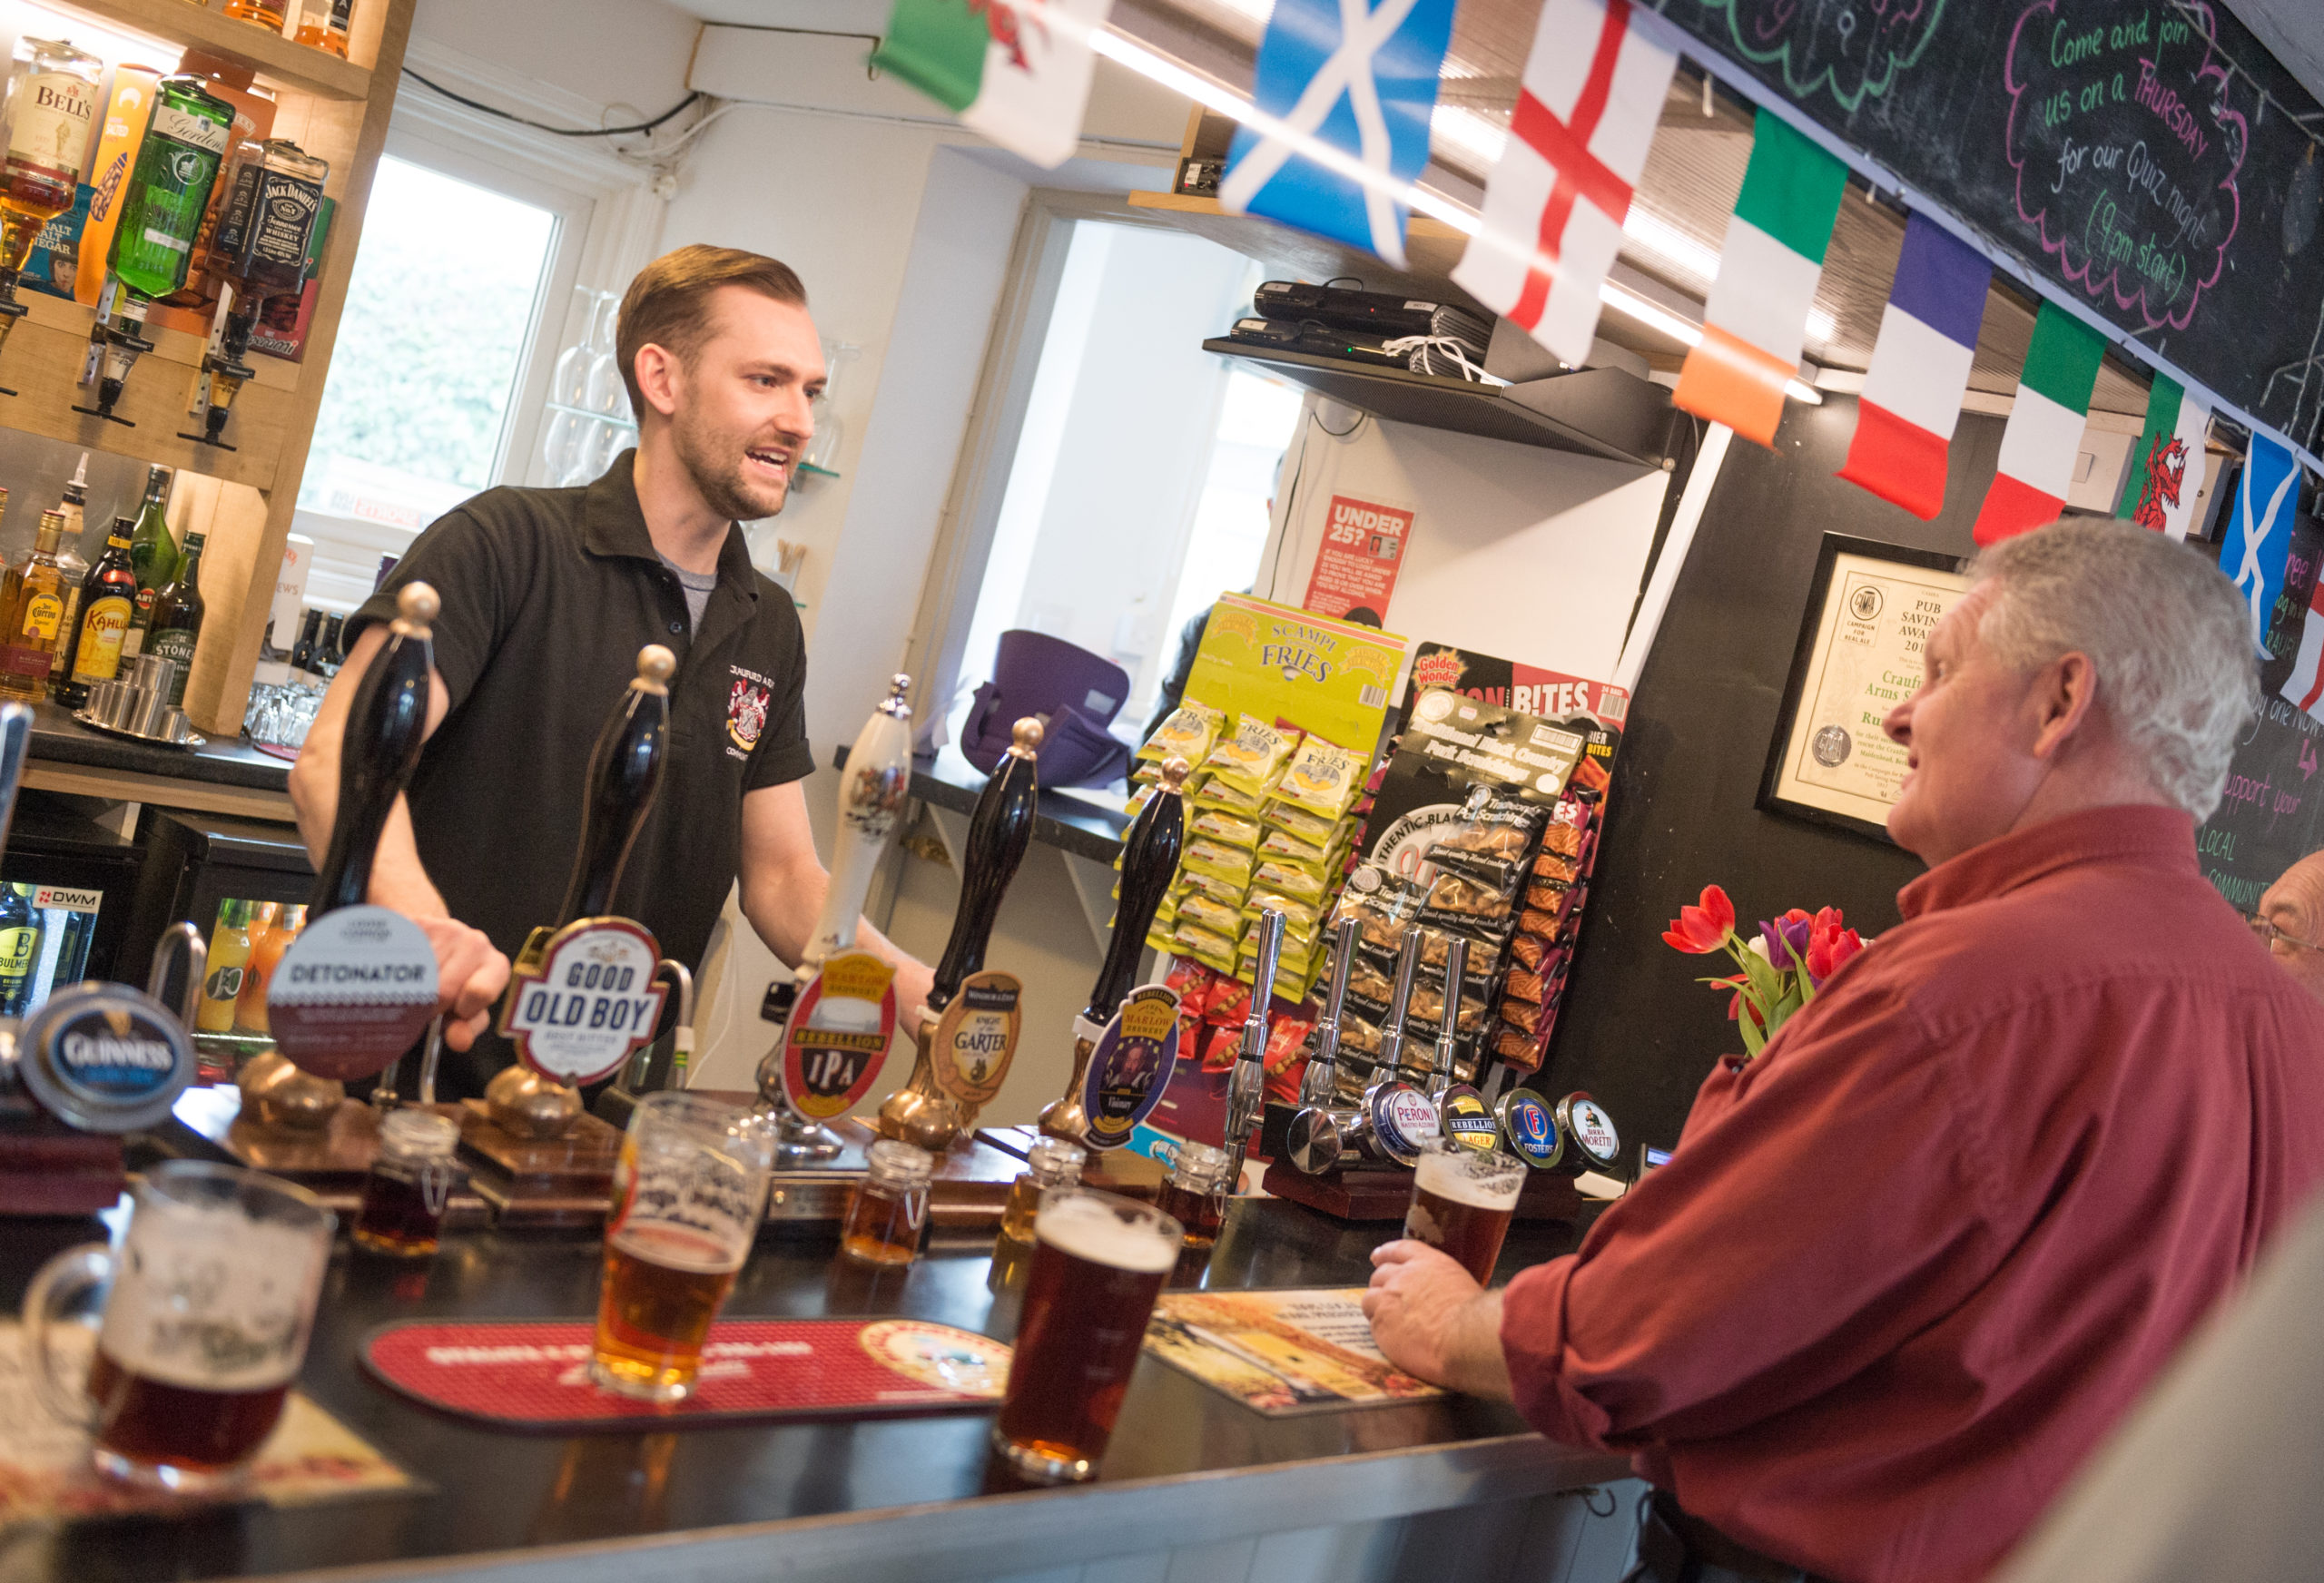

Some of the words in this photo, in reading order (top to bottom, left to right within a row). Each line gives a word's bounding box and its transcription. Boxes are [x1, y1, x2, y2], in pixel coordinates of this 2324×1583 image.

[2051, 18, 2103, 68] Come
[2111, 9, 2149, 50] and
[2143, 11, 2189, 81] join
[35, 85, 92, 120] BELL'S
[2045, 91, 2071, 127] us
[2081, 81, 2104, 113] on
[2112, 73, 2126, 102] a
[2134, 57, 2208, 162] THURSDAY
[265, 184, 287, 199] JACK
[287, 182, 318, 212] DANIEL'S
[2051, 137, 2089, 193] for
[2093, 145, 2123, 170] our
[2127, 140, 2166, 206] Quiz
[2162, 184, 2206, 250] night
[37, 229, 63, 243] ALT
[265, 228, 299, 241] WHISKEY
[249, 333, 298, 355] perami
[1334, 504, 1404, 537] UNDER
[1329, 523, 1365, 546] 25?
[1915, 600, 1941, 614] PUB
[1846, 621, 1876, 631] CAMPAIGN
[1902, 612, 1939, 626] SAVIN
[1272, 624, 1337, 653] SCAMPI
[1845, 635, 1858, 644] REAL
[1898, 626, 1930, 640] AWA
[1905, 641, 1924, 653] 201
[1261, 644, 1332, 683] FRIES
[1420, 655, 1459, 672] Golden
[1418, 670, 1460, 684] Wonder
[1865, 683, 1898, 701] Arms
[2270, 699, 2292, 727] one
[1587, 743, 1612, 757] BITES
[2224, 772, 2271, 815] upport
[2267, 788, 2301, 833] your
[2199, 825, 2236, 860] LOCAL
[2207, 868, 2272, 906] COMMUNIT
[53, 892, 95, 906] DWM
[290, 963, 426, 983] DETONATOR
[566, 962, 635, 991] GOOD
[1137, 989, 1175, 1005] REBELLION
[526, 991, 586, 1026] OLD
[589, 998, 650, 1031] BOY
[795, 1030, 883, 1050] REBELLION
[954, 1032, 1008, 1053] GARTER
[808, 1050, 855, 1089] IPA
[1397, 1107, 1433, 1121] PERONI
[1528, 1109, 1541, 1135] F
[1581, 1135, 1612, 1147] MORETTI
